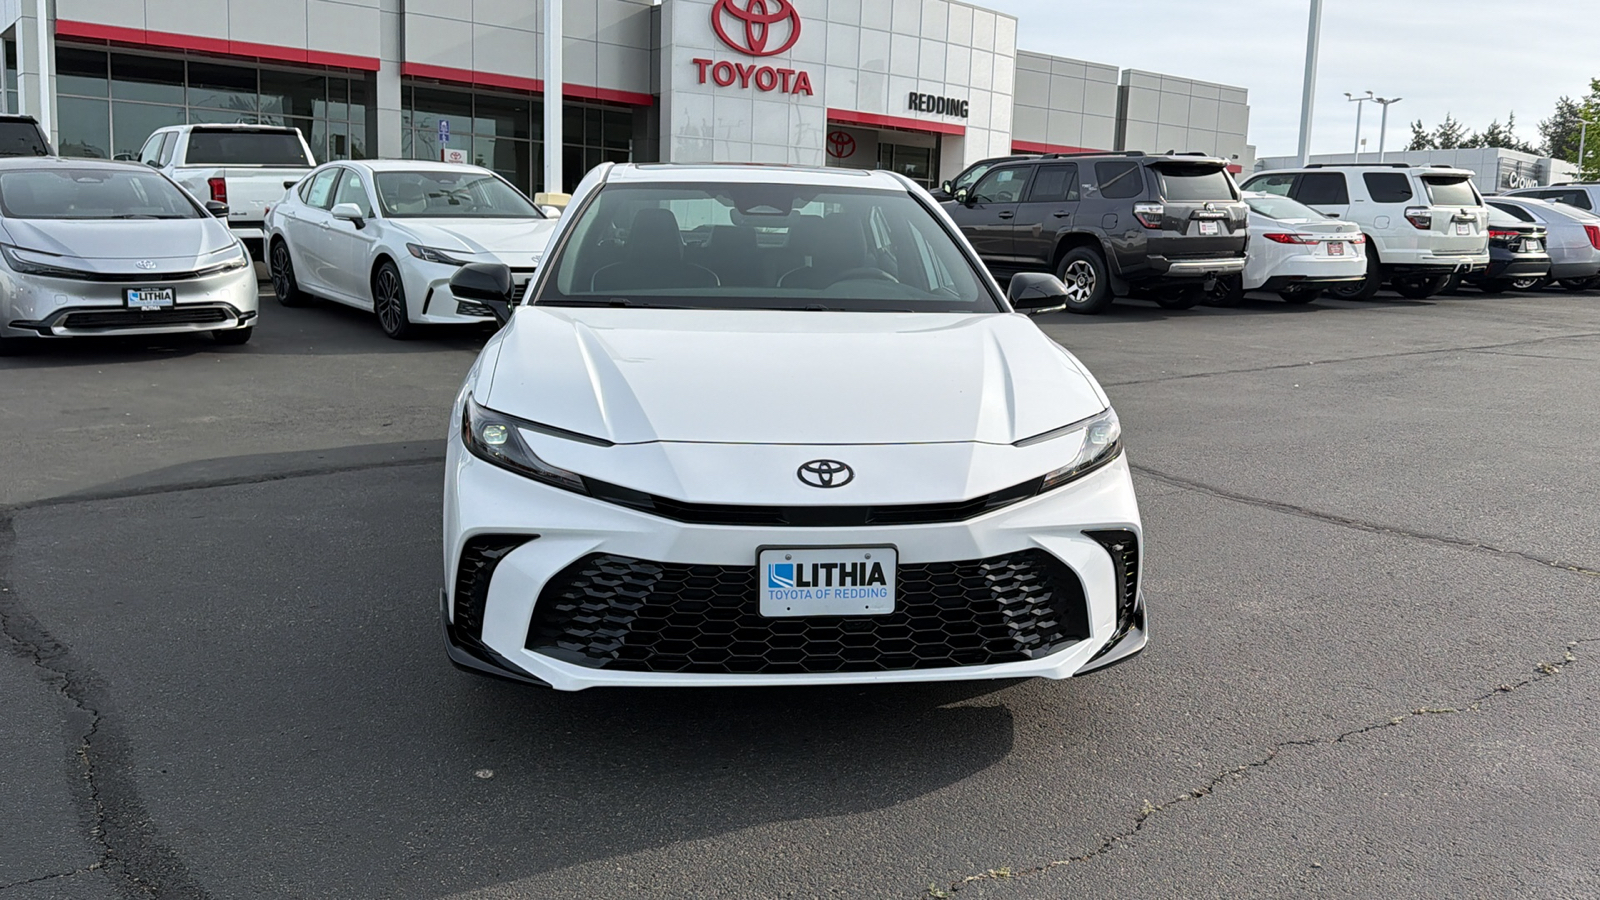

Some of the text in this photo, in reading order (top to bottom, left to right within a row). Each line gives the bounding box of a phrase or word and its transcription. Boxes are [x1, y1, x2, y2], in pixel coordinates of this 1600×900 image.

[693, 58, 814, 96] TOYOTA
[909, 92, 969, 118] REDDING
[1509, 171, 1538, 188] Crown
[139, 292, 171, 301] LITHIA
[796, 562, 887, 587] LITHIA
[768, 588, 887, 600] TOYOTA OF REDDING
